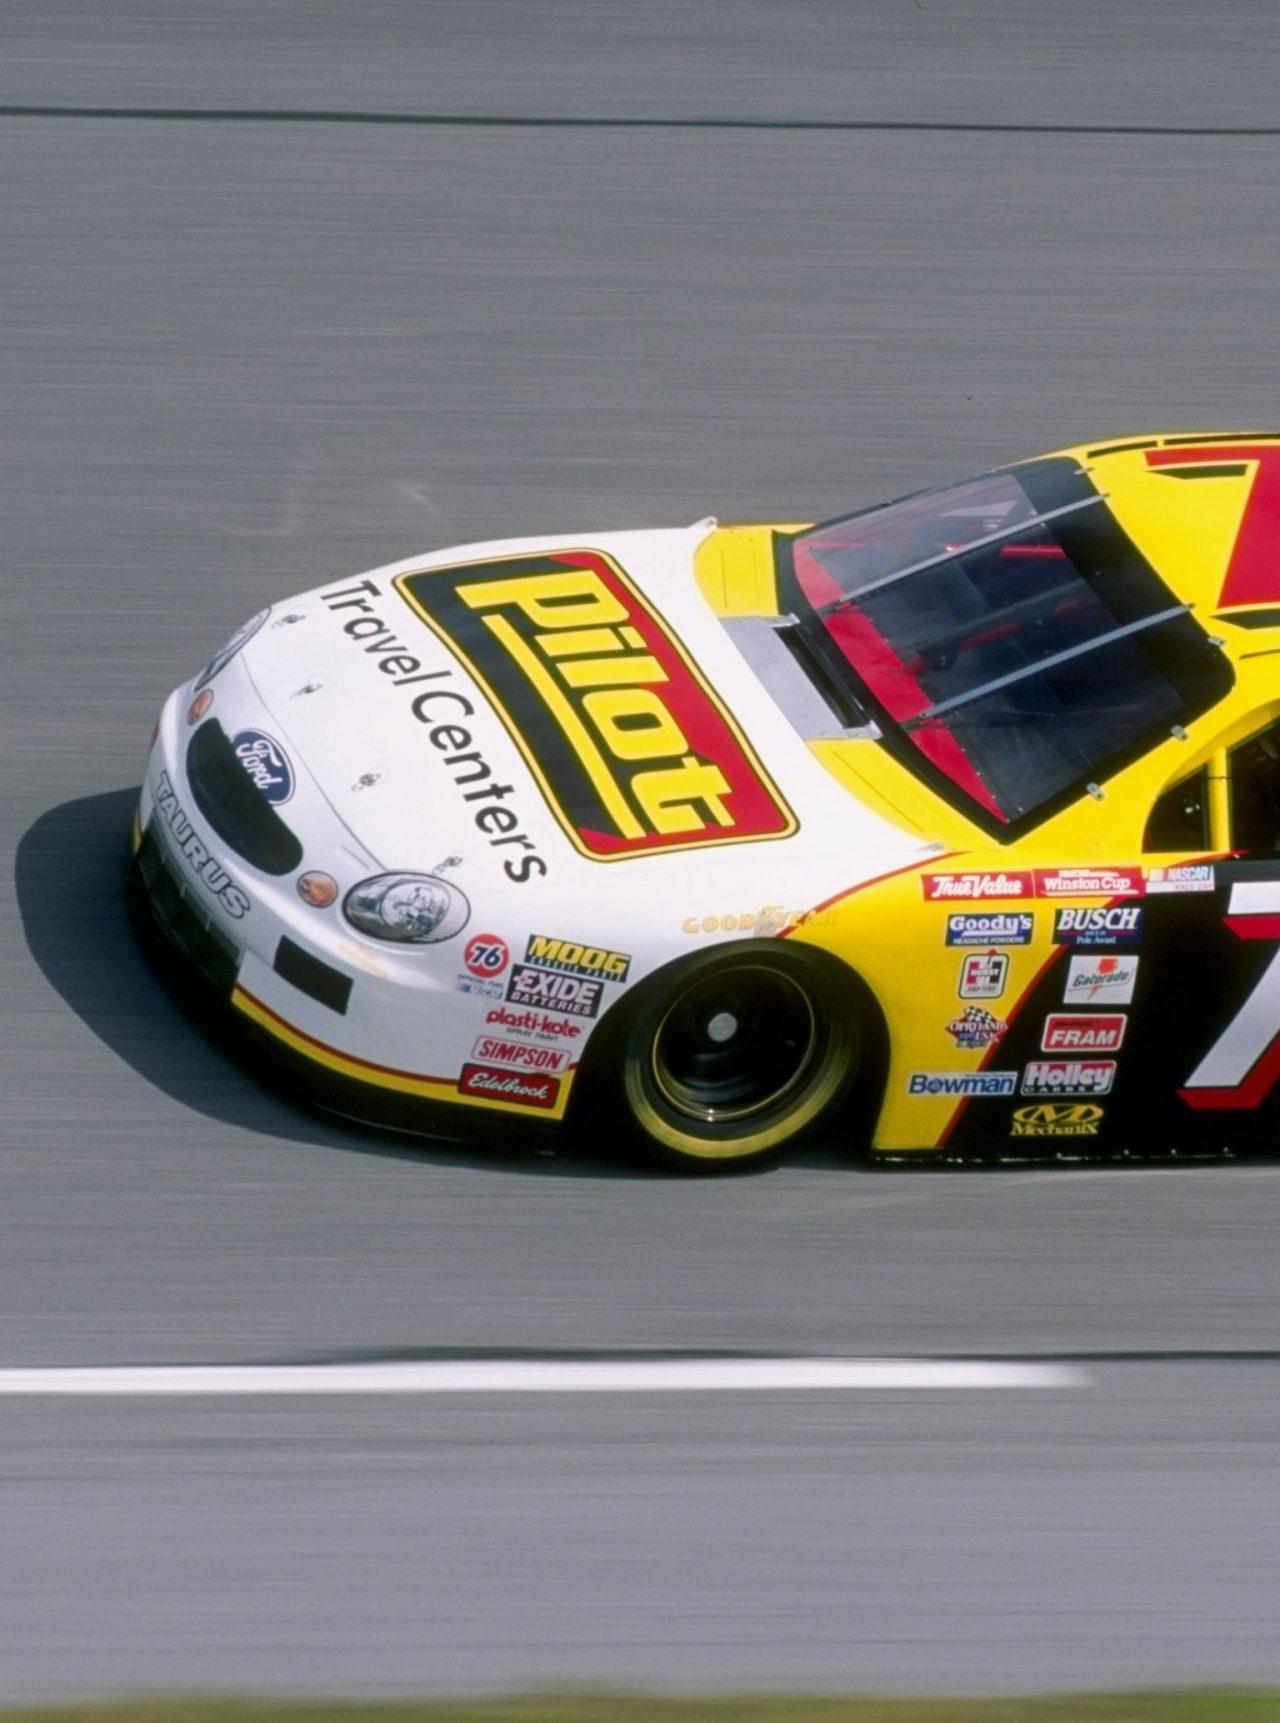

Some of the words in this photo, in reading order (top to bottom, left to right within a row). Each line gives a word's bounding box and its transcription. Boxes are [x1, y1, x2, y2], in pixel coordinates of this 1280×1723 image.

[454, 568, 738, 840] Pilot
[320, 579, 454, 687] Travel
[411, 690, 547, 883] Centers
[234, 736, 285, 792] Ford
[152, 769, 251, 920] TAURUS
[1044, 876, 1100, 891] Winston
[1101, 875, 1131, 892] Cup
[1168, 865, 1211, 881] NASCAR
[949, 914, 1033, 935] Goody's
[1057, 908, 1140, 930] BUSCH
[1076, 936, 1093, 945] Pole
[1094, 936, 1117, 945] Award
[470, 944, 503, 969] 76
[528, 936, 630, 974] MOOG
[516, 968, 600, 1005] EXIDE
[1072, 970, 1129, 987] Gatorade
[510, 990, 594, 1016] BATTERIES
[485, 1006, 582, 1038] plasti-kote
[1050, 1030, 1117, 1046] FRAM
[478, 1040, 564, 1070] SIMPSON
[467, 1072, 550, 1100] Edelbrock
[909, 1074, 1015, 1094] Bowman
[1025, 1063, 1113, 1091] Holley
